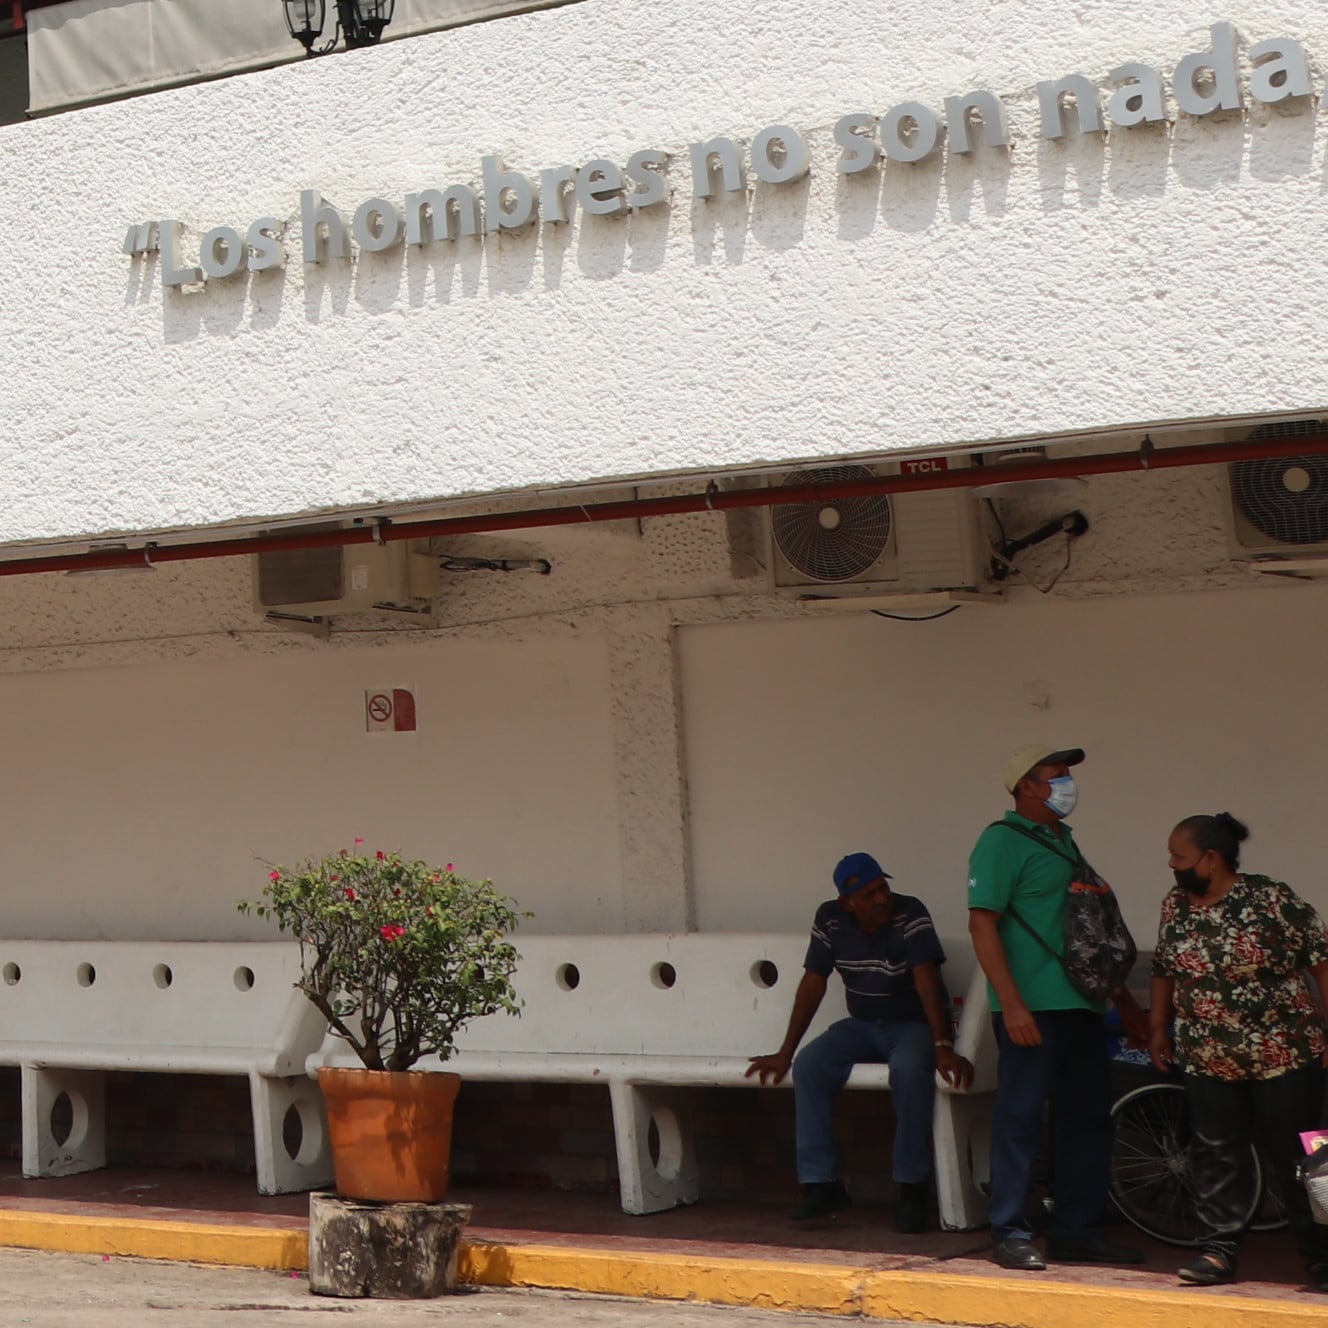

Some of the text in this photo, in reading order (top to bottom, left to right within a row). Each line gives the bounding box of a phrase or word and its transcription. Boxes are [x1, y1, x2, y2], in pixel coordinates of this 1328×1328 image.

[300, 149, 672, 264] hombres
[689, 124, 810, 198] no
[833, 90, 1011, 172] son
[907, 460, 942, 473] TCL
